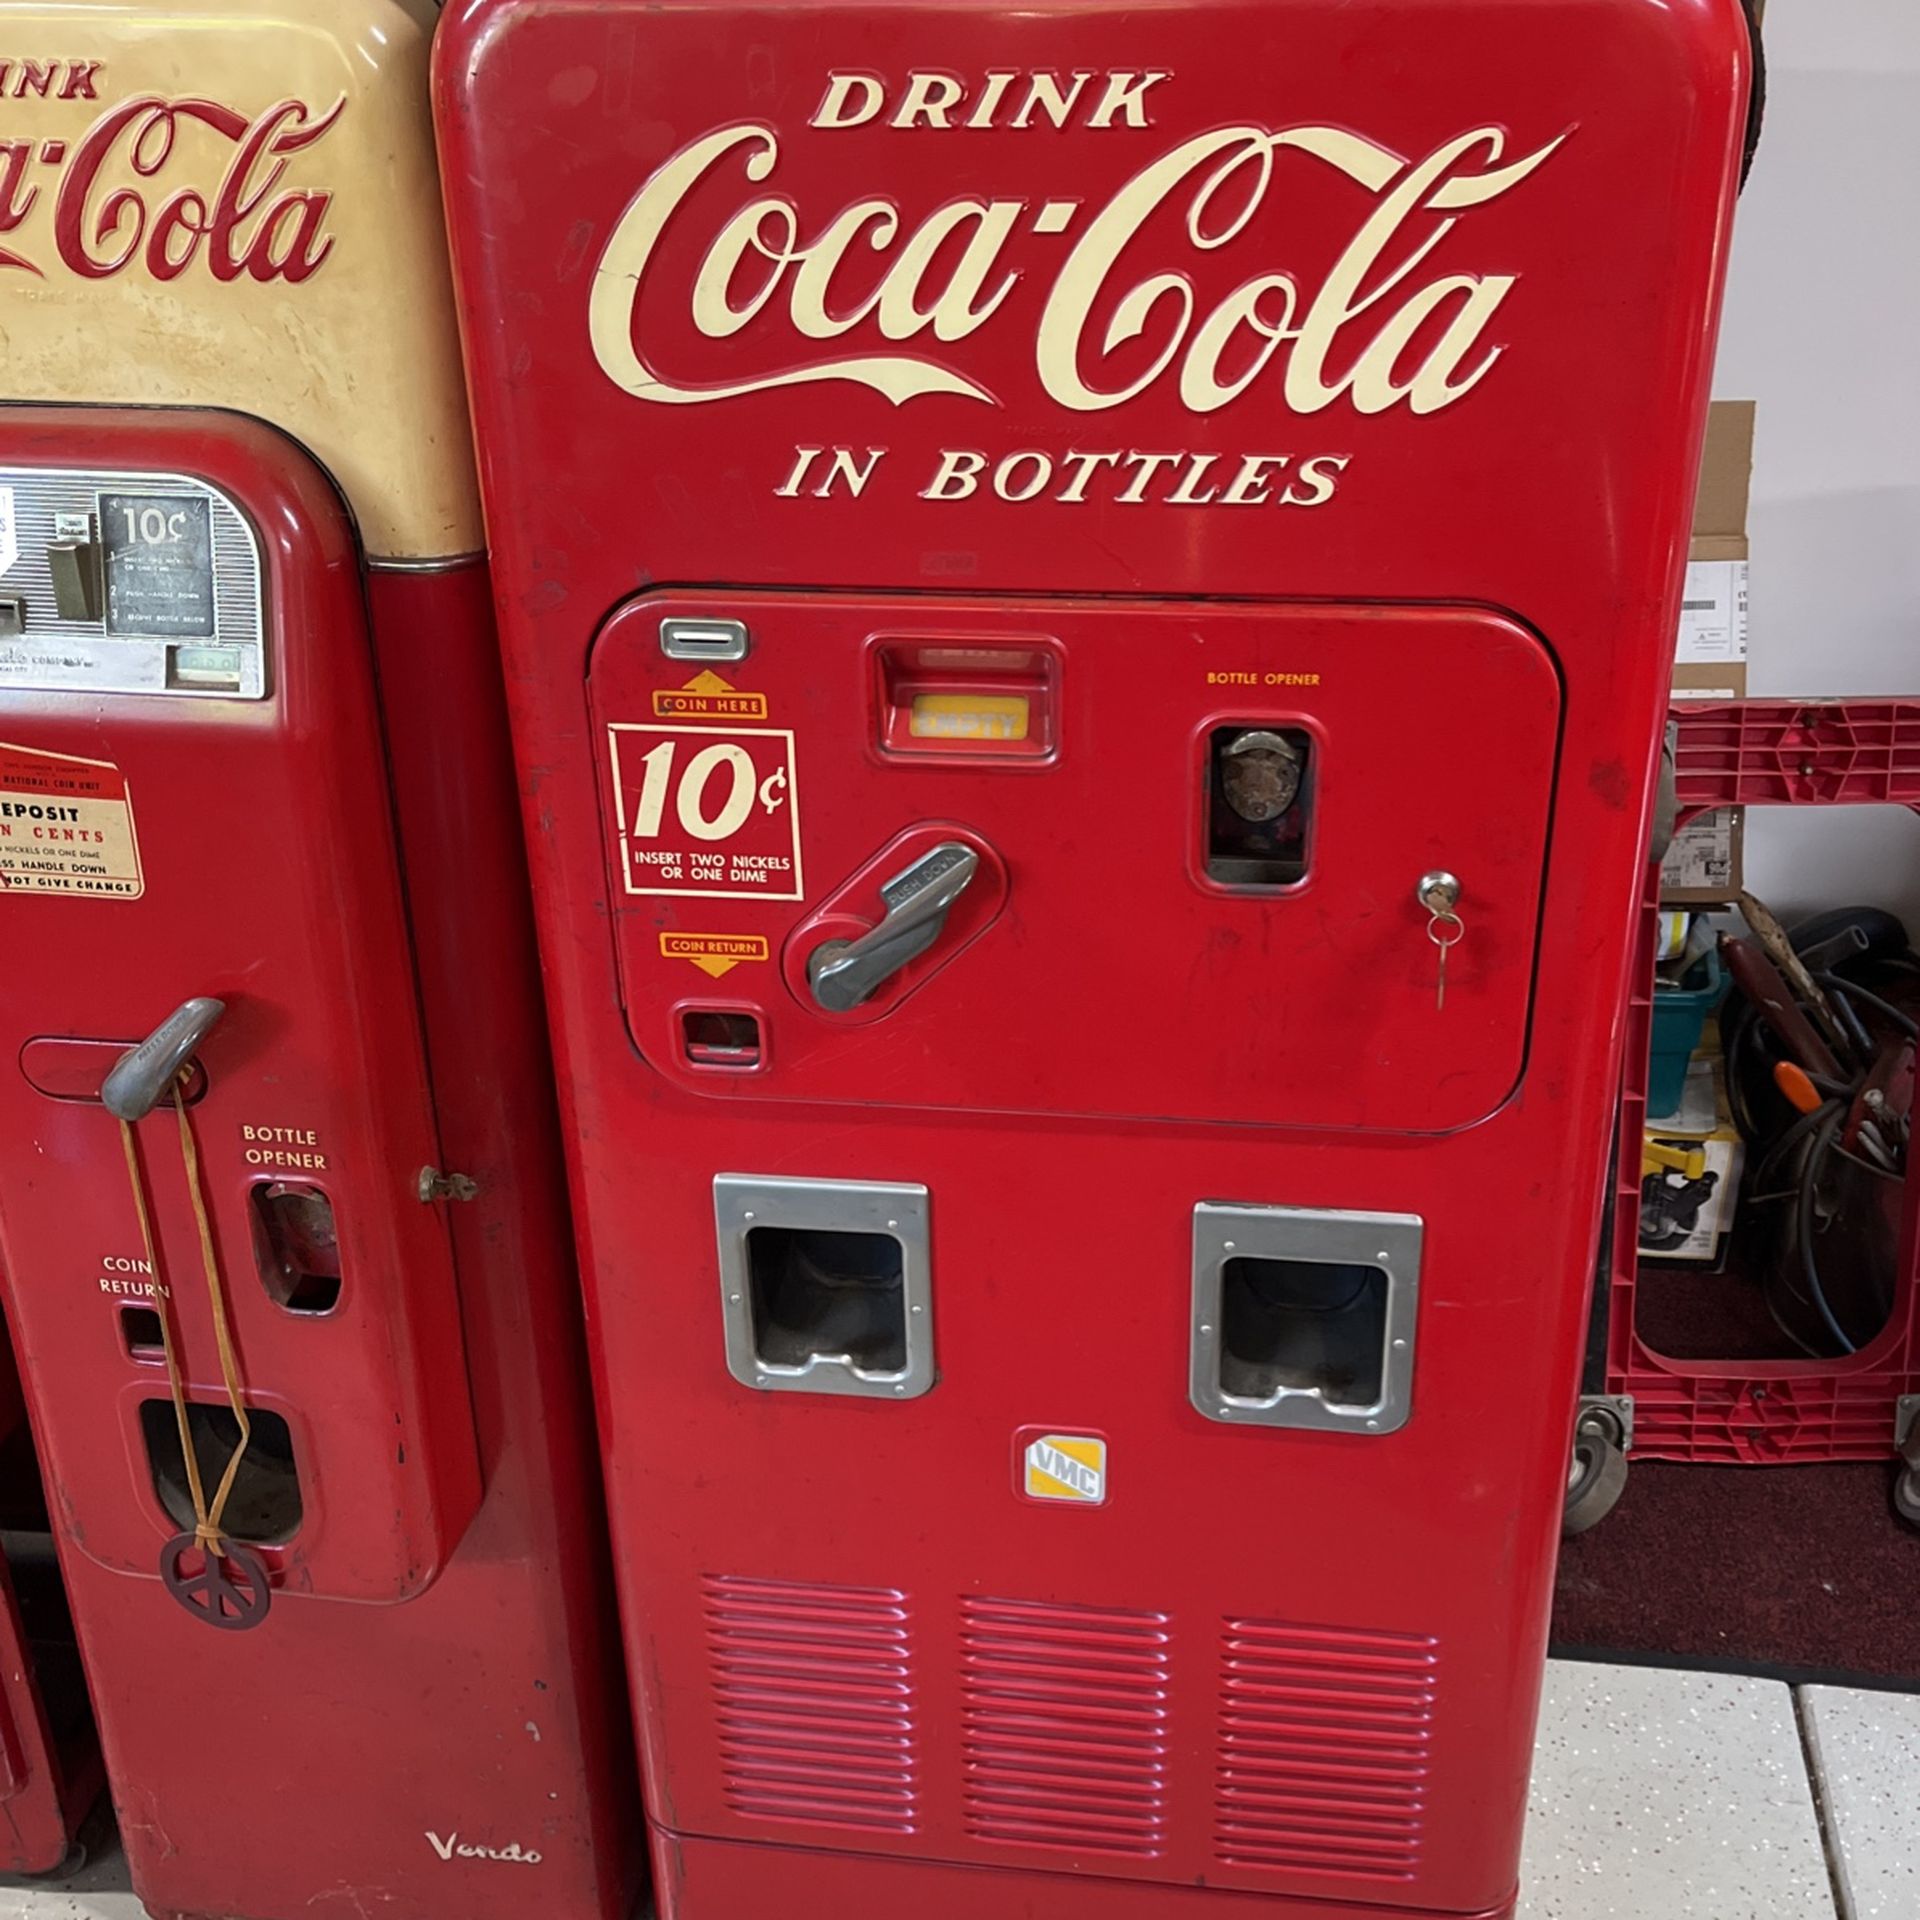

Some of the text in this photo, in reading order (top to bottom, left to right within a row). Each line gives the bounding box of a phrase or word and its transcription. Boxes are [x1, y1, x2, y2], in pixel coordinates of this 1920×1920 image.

[808, 70, 1170, 130] DRINK
[588, 122, 1572, 416] Coca-Cola
[774, 446, 1350, 506] IN BOTTLES
[123, 508, 186, 544] 10¢
[1207, 672, 1321, 686] BOTTLE OPENER
[662, 698, 759, 713] COIN HERE
[633, 740, 788, 842] 10¢
[33, 827, 104, 843] CENTS
[58, 849, 77, 858] ONE
[80, 851, 100, 860] DIME
[634, 851, 790, 871] INSERT TWO NICKELS
[21, 861, 65, 872] HANDLE
[72, 863, 107, 874] DOWN
[661, 866, 768, 883] OR ONE DIME
[38, 878, 71, 889] GIVE
[77, 879, 133, 892] CHANGE
[888, 853, 957, 905] PUSH DOWN
[671, 940, 757, 954] COIN RETURN
[242, 1125, 317, 1146] BOTTLE
[245, 1149, 327, 1170] OPENER
[103, 1256, 152, 1275] COIN
[99, 1278, 171, 1299] RETURN
[1035, 1441, 1096, 1495] VMC
[424, 1830, 542, 1864] Vendo
